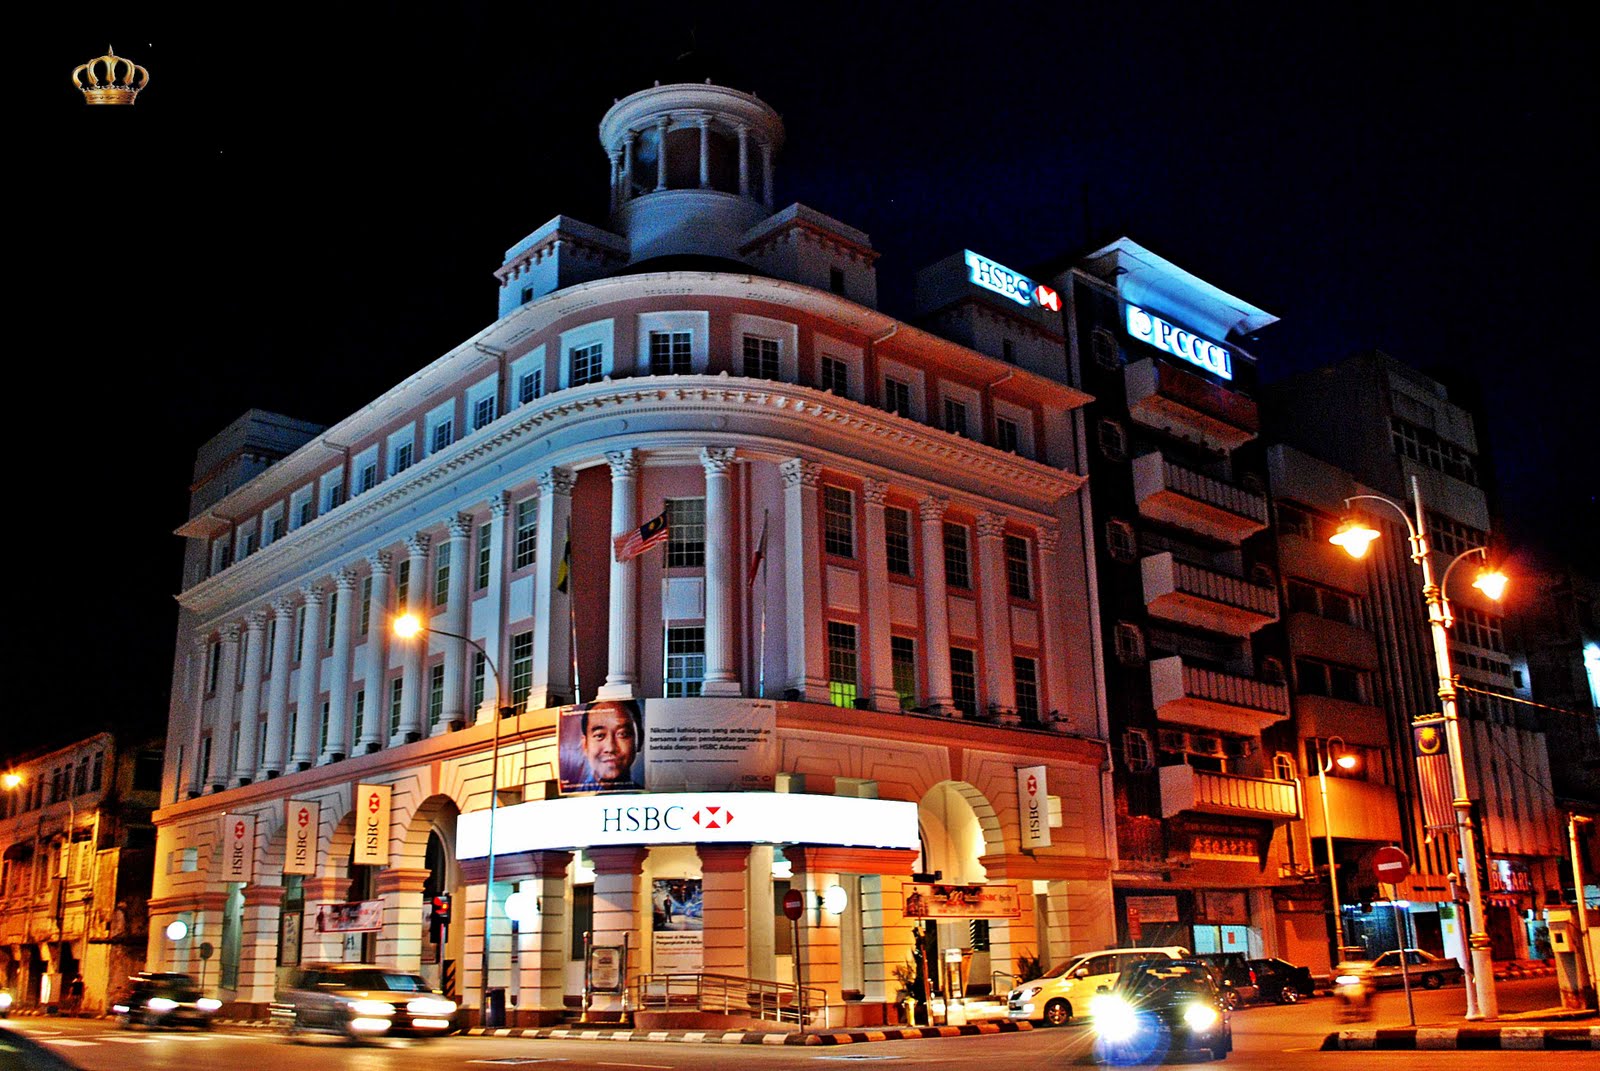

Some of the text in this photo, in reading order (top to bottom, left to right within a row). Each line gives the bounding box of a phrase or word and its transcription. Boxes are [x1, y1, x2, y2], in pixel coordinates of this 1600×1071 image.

[976, 259, 1033, 300] HSBC
[1159, 319, 1231, 374] PCCCI
[366, 816, 380, 856] HSBC
[602, 805, 684, 832] HSBC
[1029, 799, 1041, 840] HSBC
[232, 841, 244, 875] HSBC
[295, 831, 307, 866] HSBC
